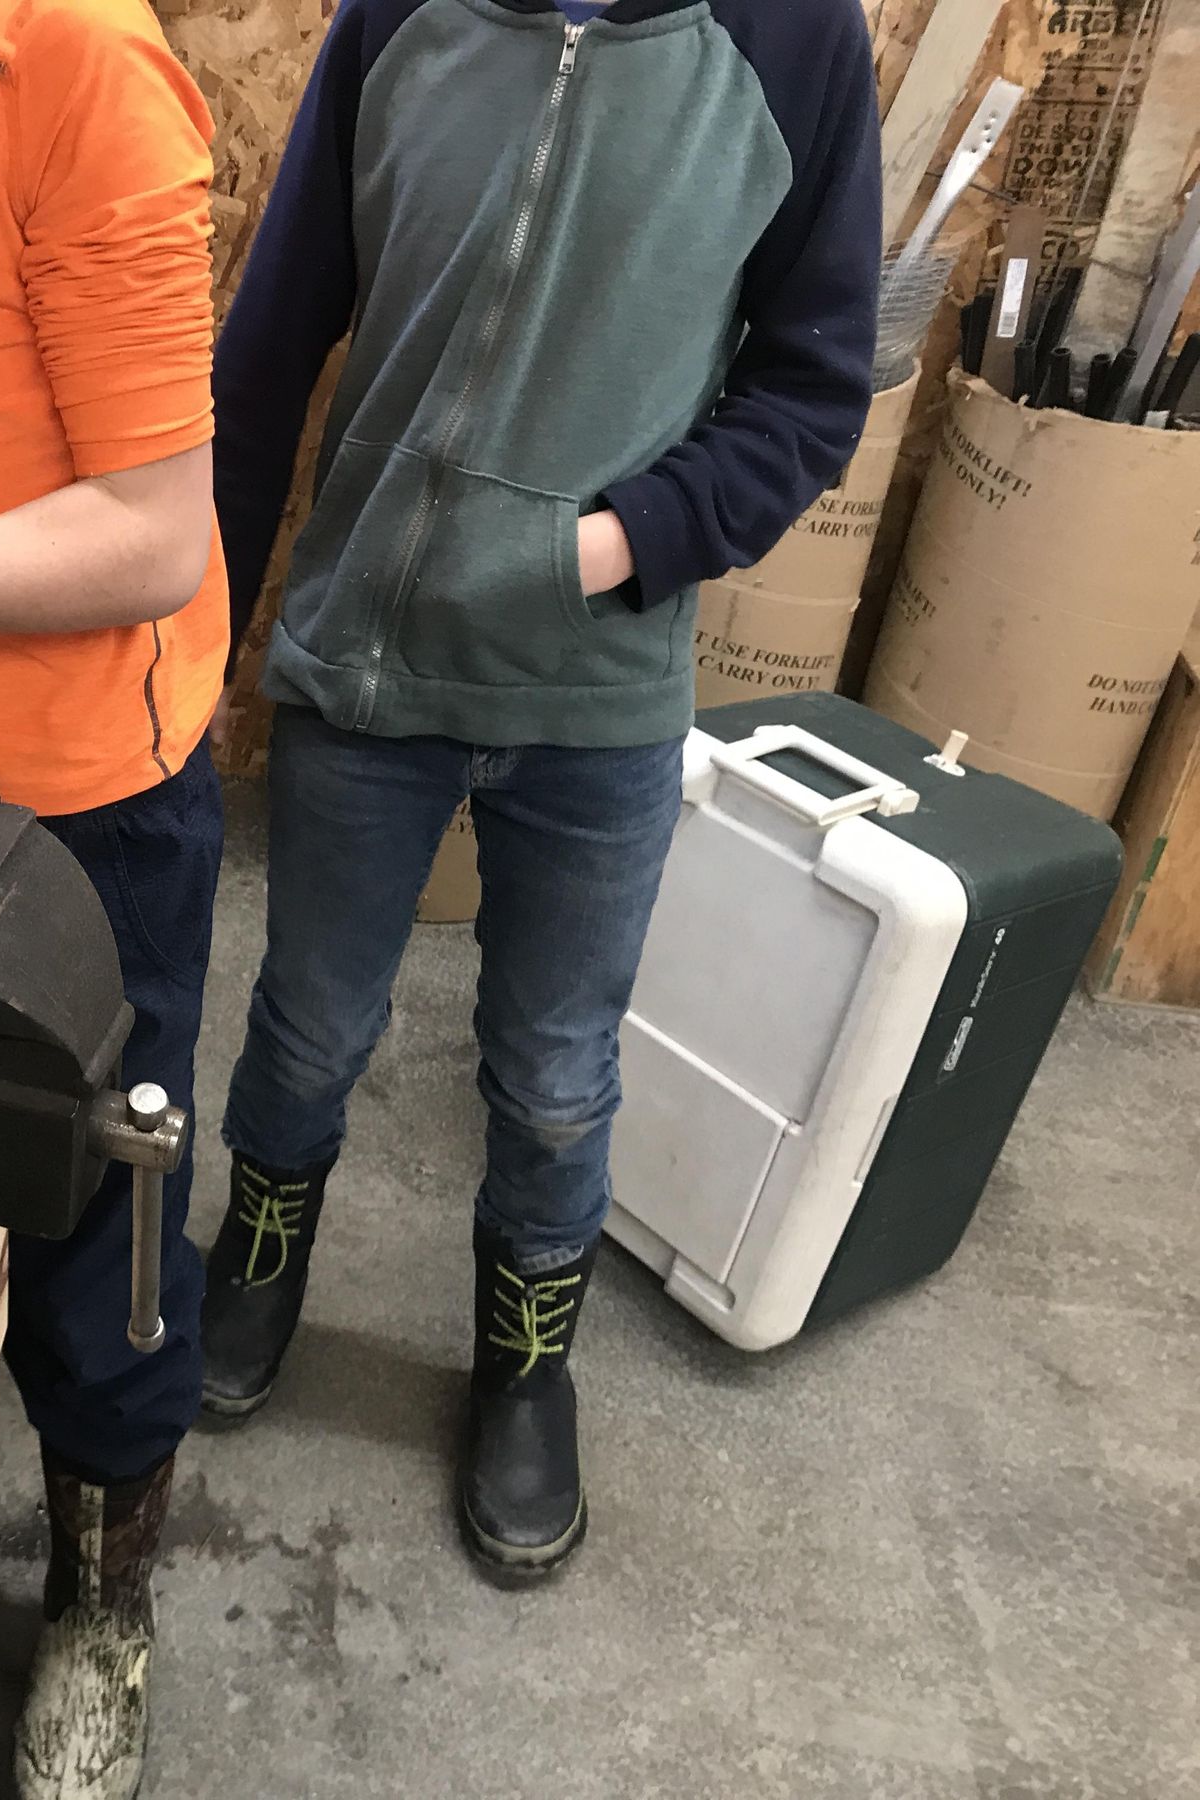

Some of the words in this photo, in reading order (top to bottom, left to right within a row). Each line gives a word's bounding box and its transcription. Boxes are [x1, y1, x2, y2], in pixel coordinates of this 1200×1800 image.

[956, 463, 1007, 510] ONLY!
[711, 636, 750, 660] USE
[698, 654, 770, 685] CARRY
[1087, 673, 1118, 692] DO
